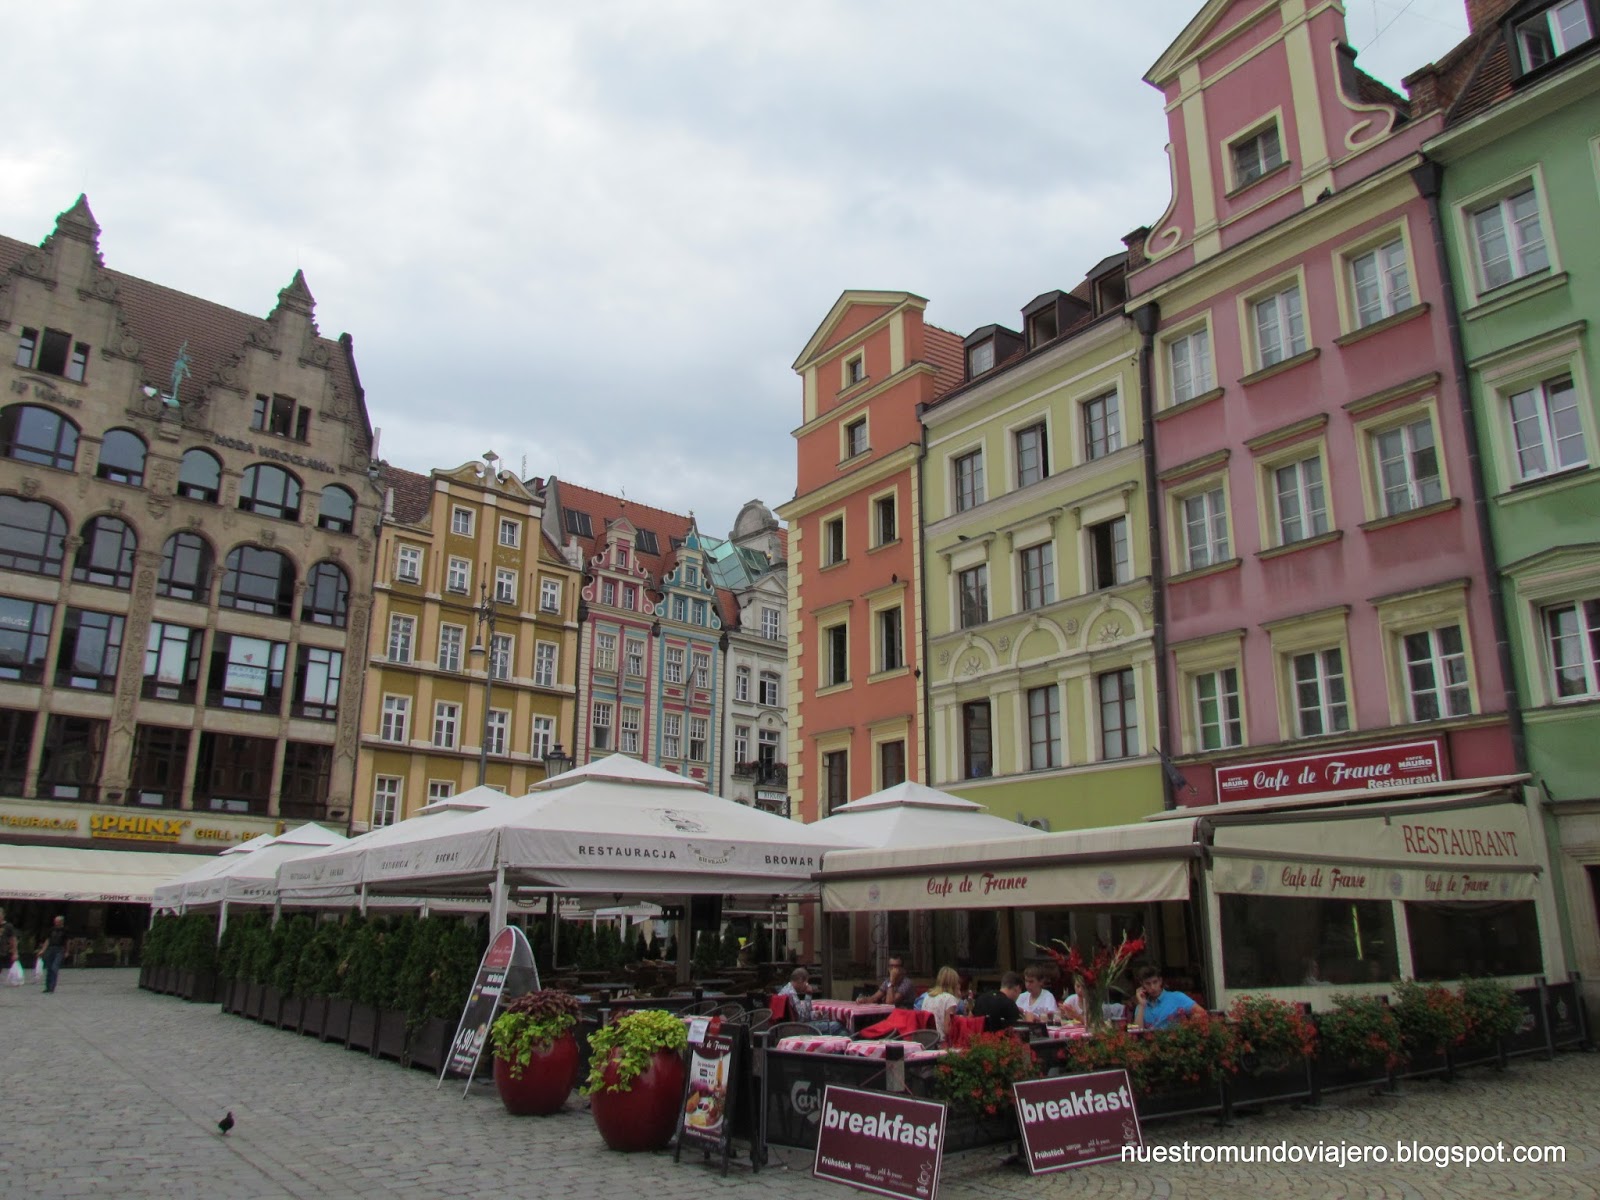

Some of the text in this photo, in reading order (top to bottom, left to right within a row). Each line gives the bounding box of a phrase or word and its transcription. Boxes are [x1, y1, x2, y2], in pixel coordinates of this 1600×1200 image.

[1398, 758, 1433, 768] MAURO
[1222, 779, 1249, 788] MAURO
[1253, 761, 1393, 791] Cafe de France
[1367, 772, 1437, 790] Restaurant
[195, 828, 231, 841] GRILL
[1402, 824, 1519, 857] RESTAURANT
[578, 845, 677, 860] RESTAURACJA
[764, 854, 815, 867] BROWAR
[927, 872, 1028, 897] Cafe de France
[1020, 1084, 1131, 1124] breakfast
[824, 1102, 938, 1150] breakfast
[1034, 1147, 1065, 1160] Frühstück
[821, 1156, 852, 1171] Frühstück
